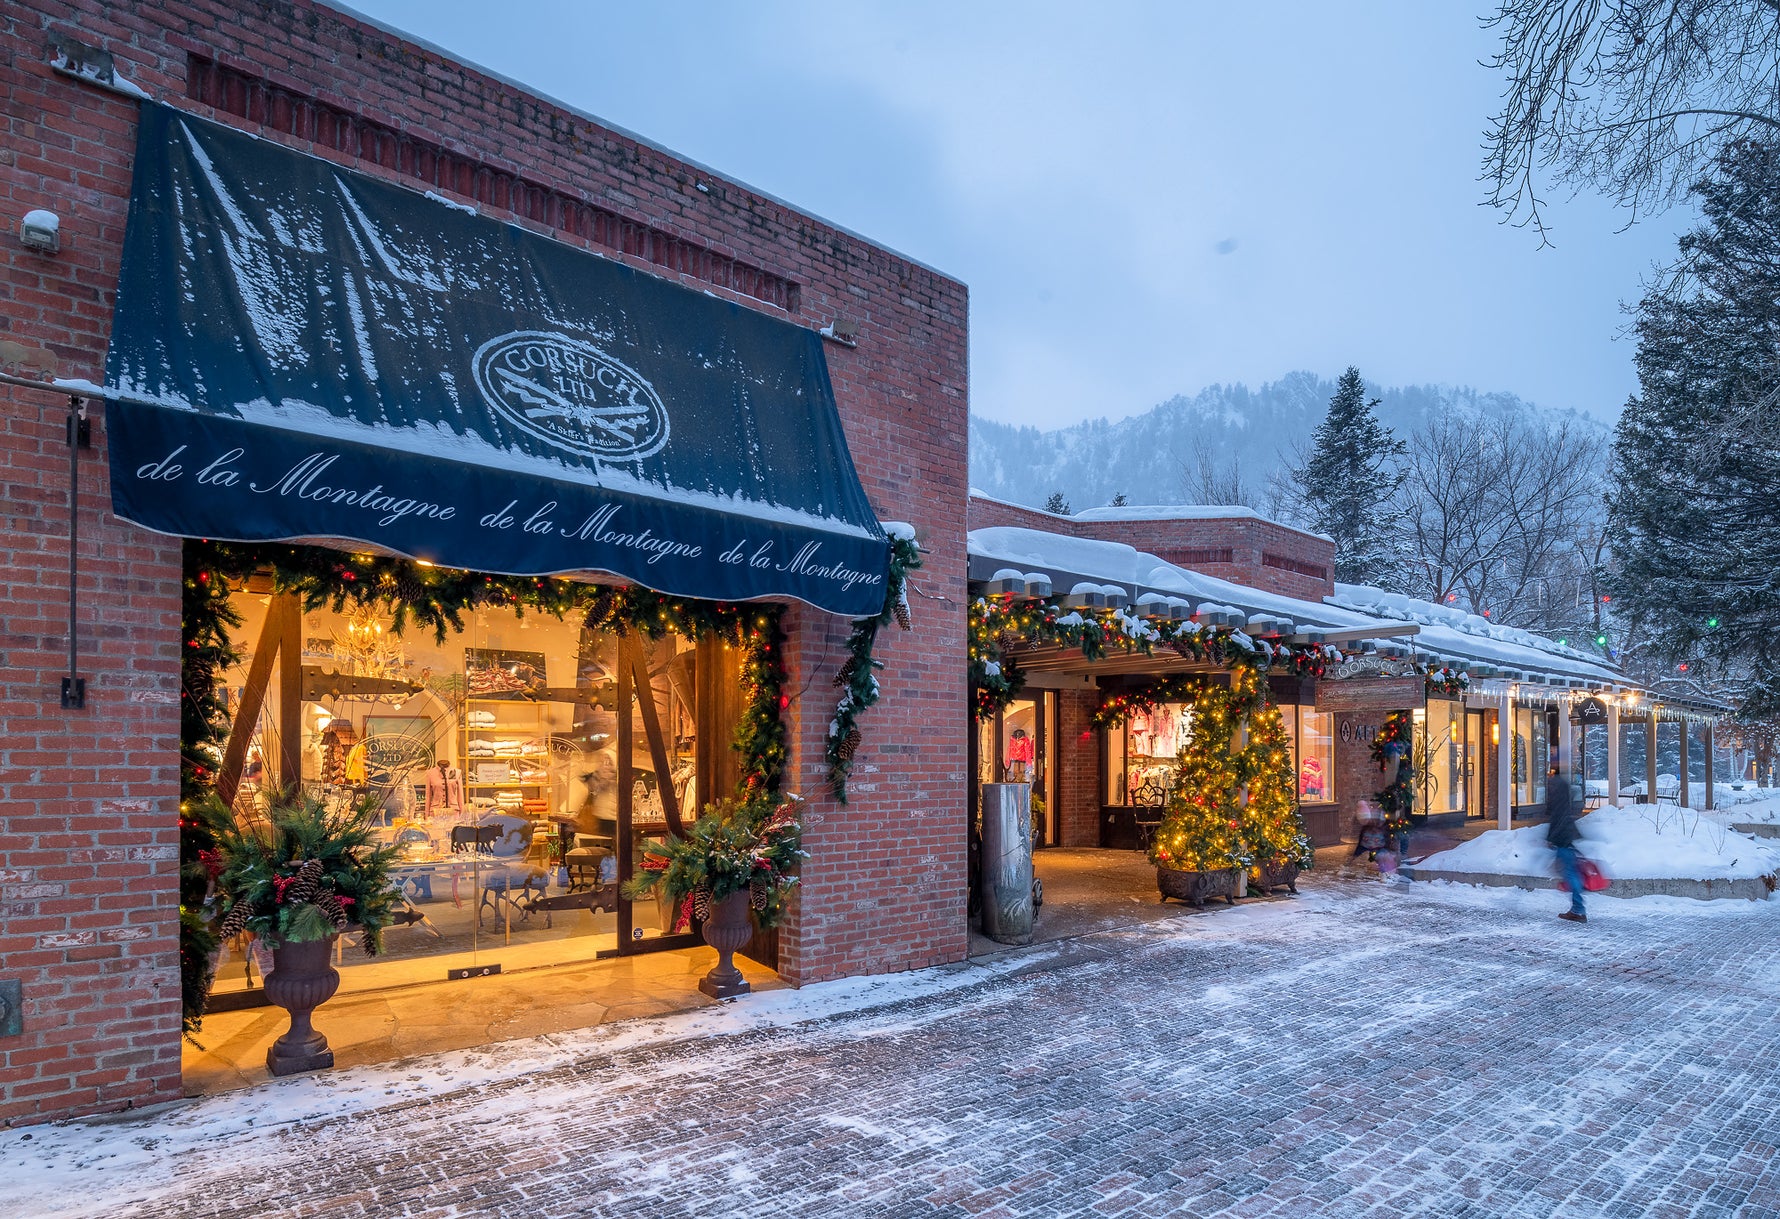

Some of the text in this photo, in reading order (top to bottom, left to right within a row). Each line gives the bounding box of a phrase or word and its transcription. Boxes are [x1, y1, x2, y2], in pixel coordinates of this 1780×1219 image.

[505, 346, 642, 407] GORSUCH
[137, 444, 883, 591] de la Montagne de la Montagne de la Montagne
